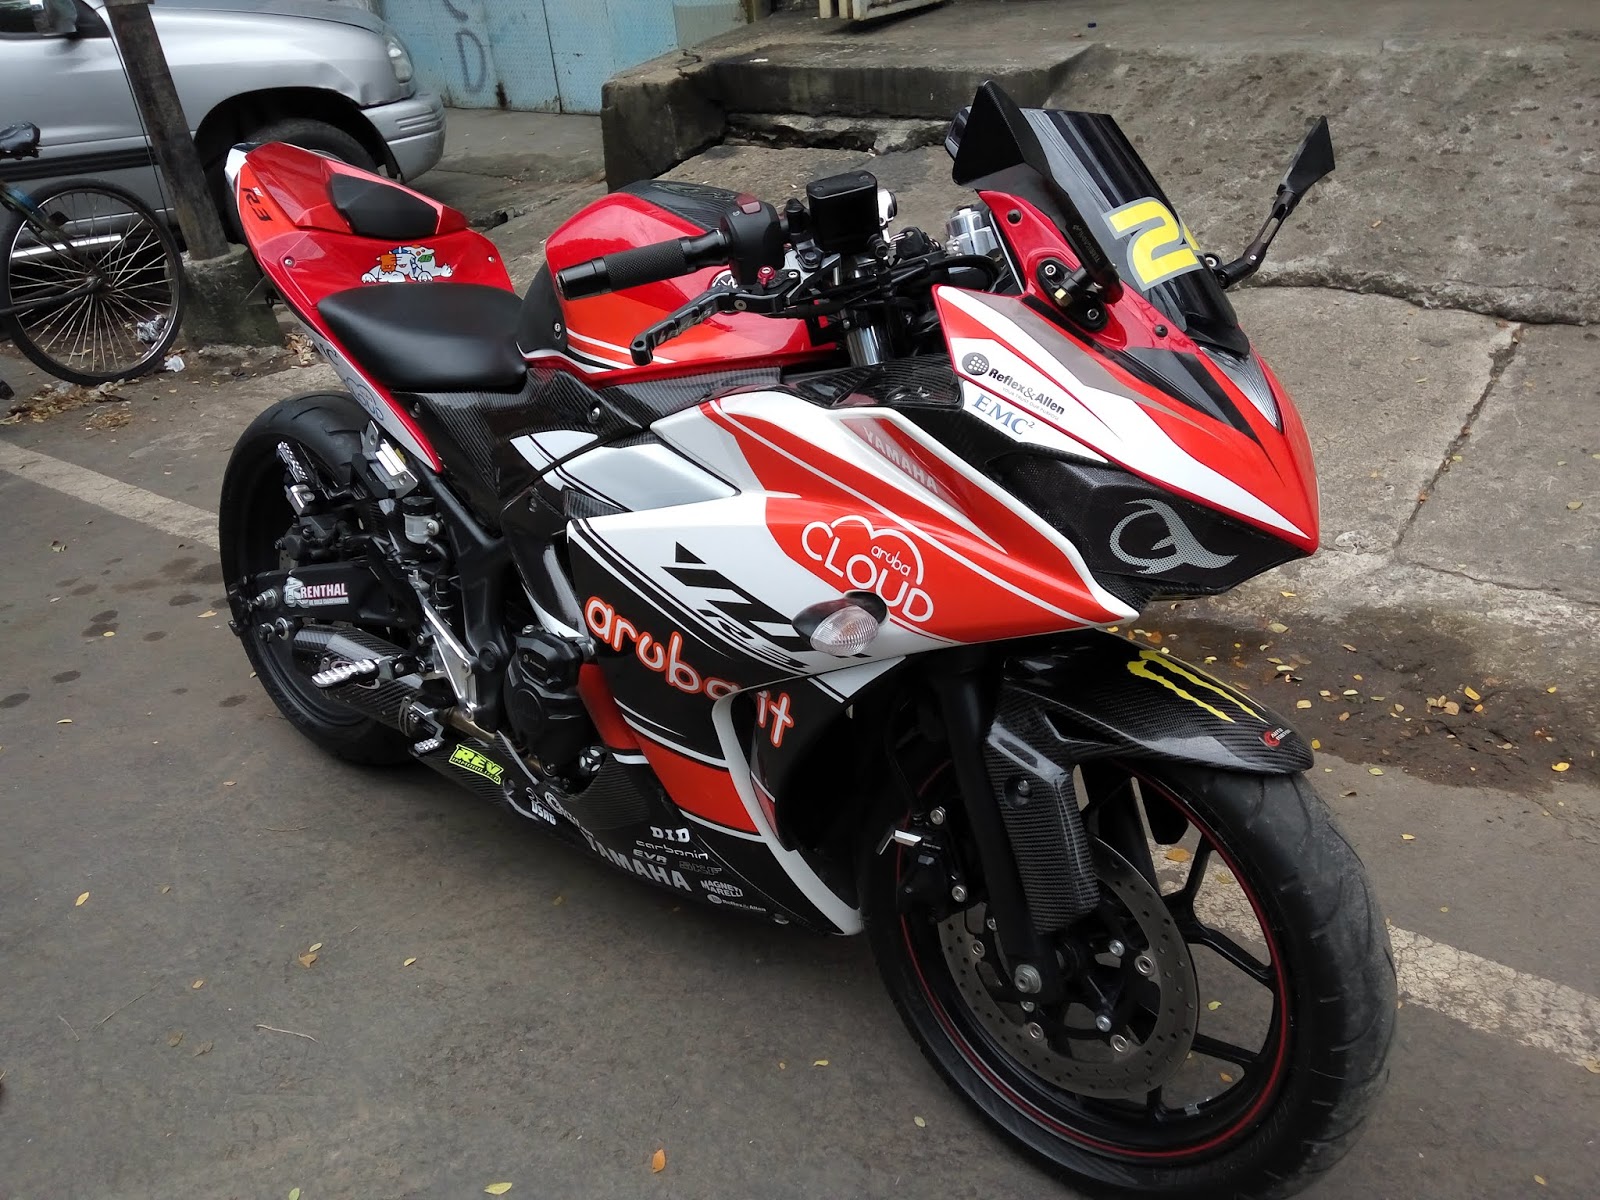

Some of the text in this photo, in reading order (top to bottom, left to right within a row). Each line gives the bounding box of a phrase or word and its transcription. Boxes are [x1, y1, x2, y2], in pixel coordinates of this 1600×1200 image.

[864, 426, 939, 494] YAMAHA
[801, 521, 934, 622] CLOUD
[871, 545, 911, 577] aruba
[300, 582, 349, 599] RENTHAL
[454, 748, 501, 775] REV
[580, 827, 692, 892] YAMAHA
[632, 848, 668, 864] EVR
[635, 839, 709, 861] carbonin
